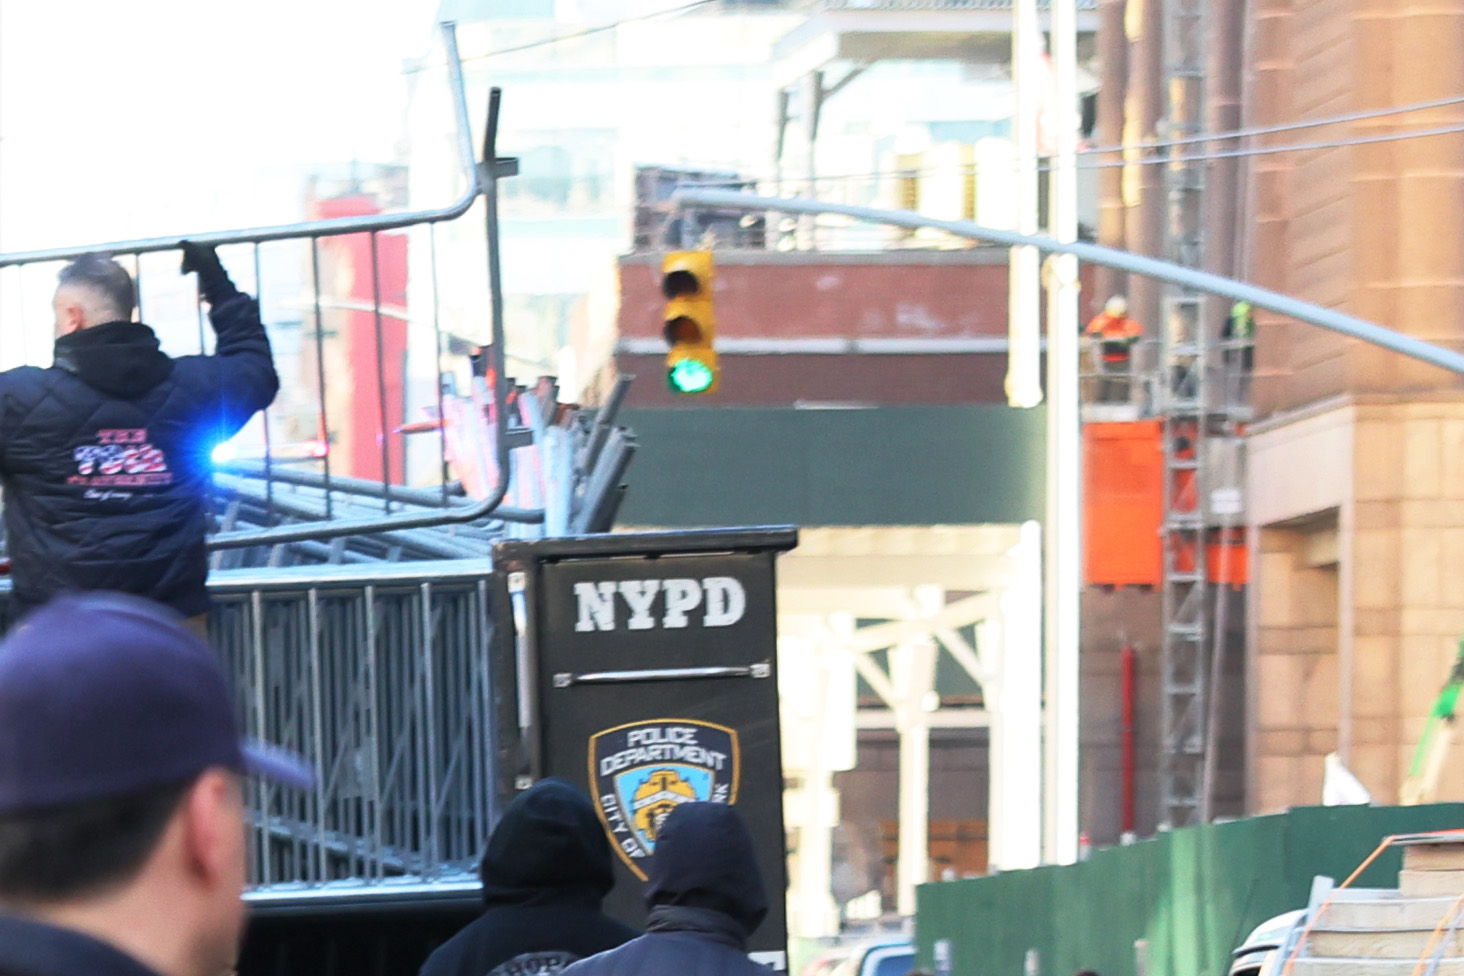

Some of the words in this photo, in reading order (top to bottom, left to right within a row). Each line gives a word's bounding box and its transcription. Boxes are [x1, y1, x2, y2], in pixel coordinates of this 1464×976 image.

[573, 577, 746, 632] NYPD
[627, 727, 698, 748] POLICE
[600, 744, 727, 776] DEPARTMENT
[600, 793, 628, 833] CITY
[621, 837, 646, 858] OF
